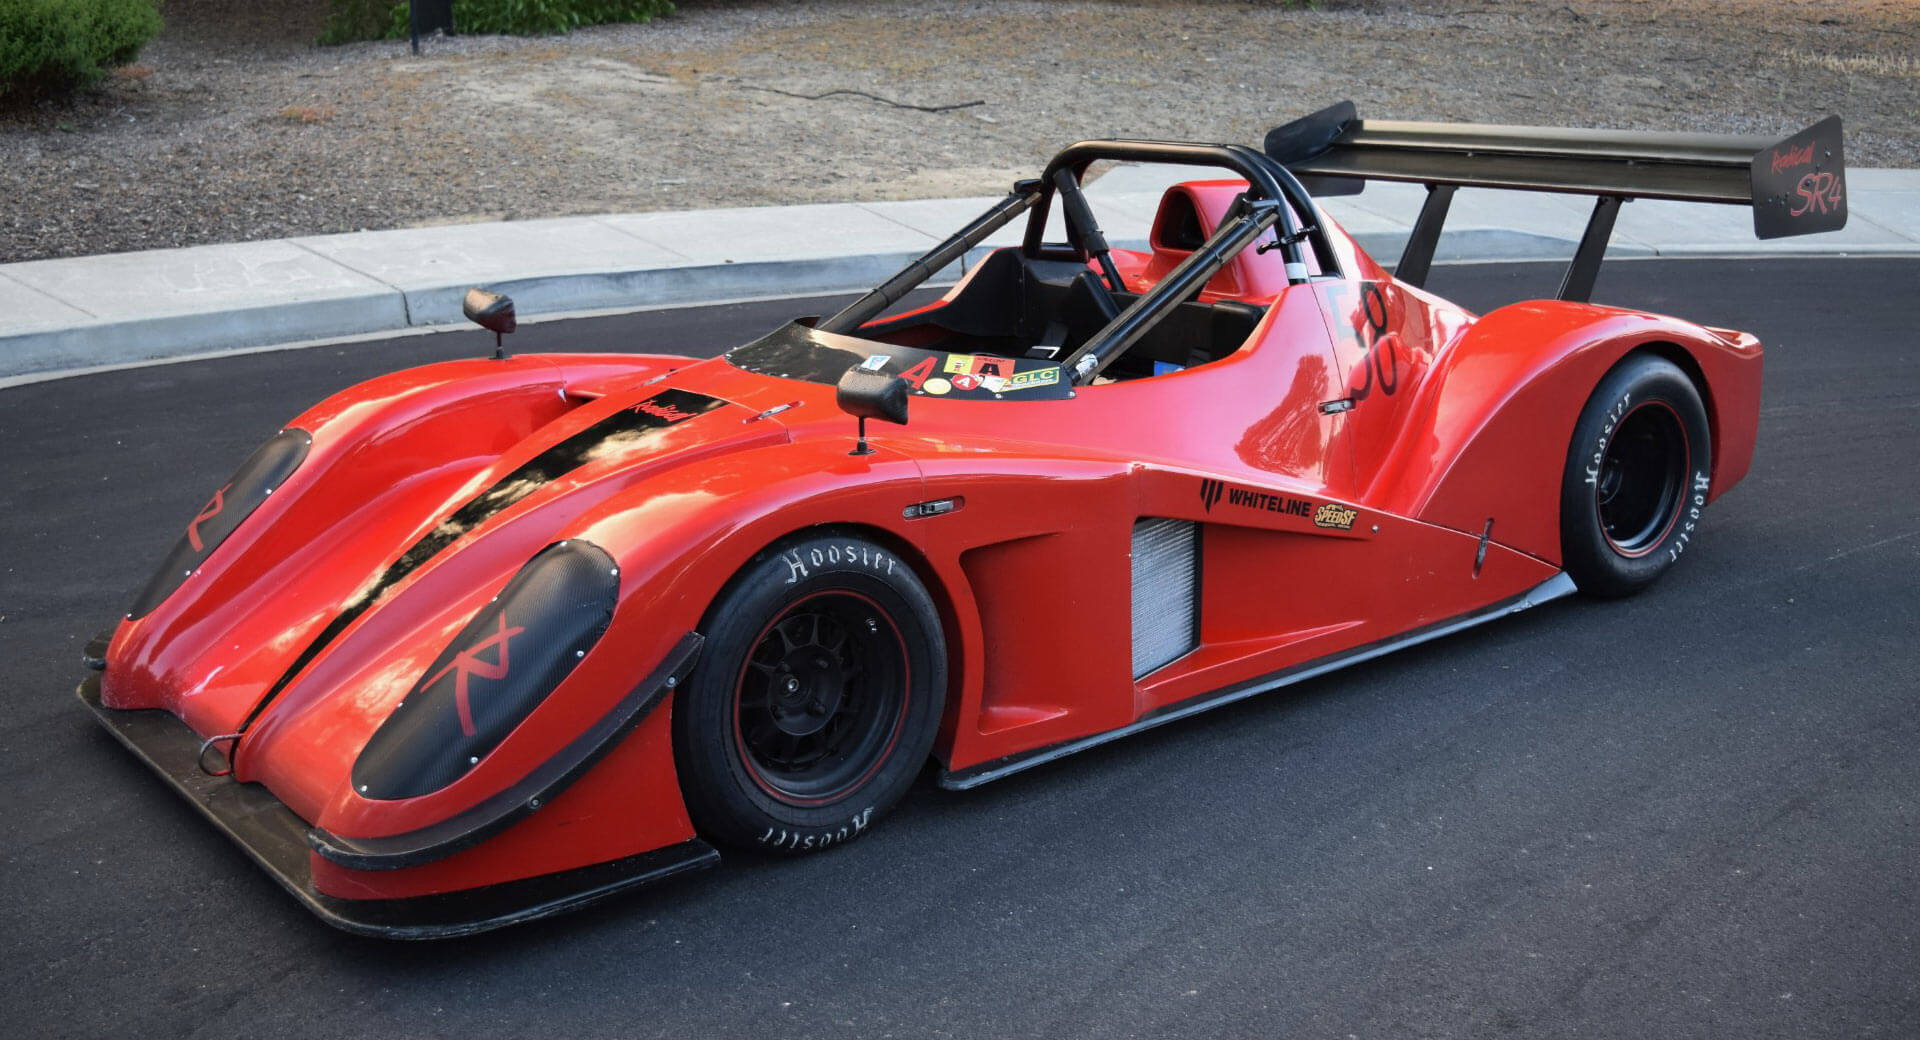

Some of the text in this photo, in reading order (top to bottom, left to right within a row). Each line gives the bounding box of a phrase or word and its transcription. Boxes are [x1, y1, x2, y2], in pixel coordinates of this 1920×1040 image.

[1790, 172, 1841, 217] SR4
[897, 356, 938, 390] A
[979, 362, 1001, 377] A
[1229, 487, 1312, 518] WHITELINE
